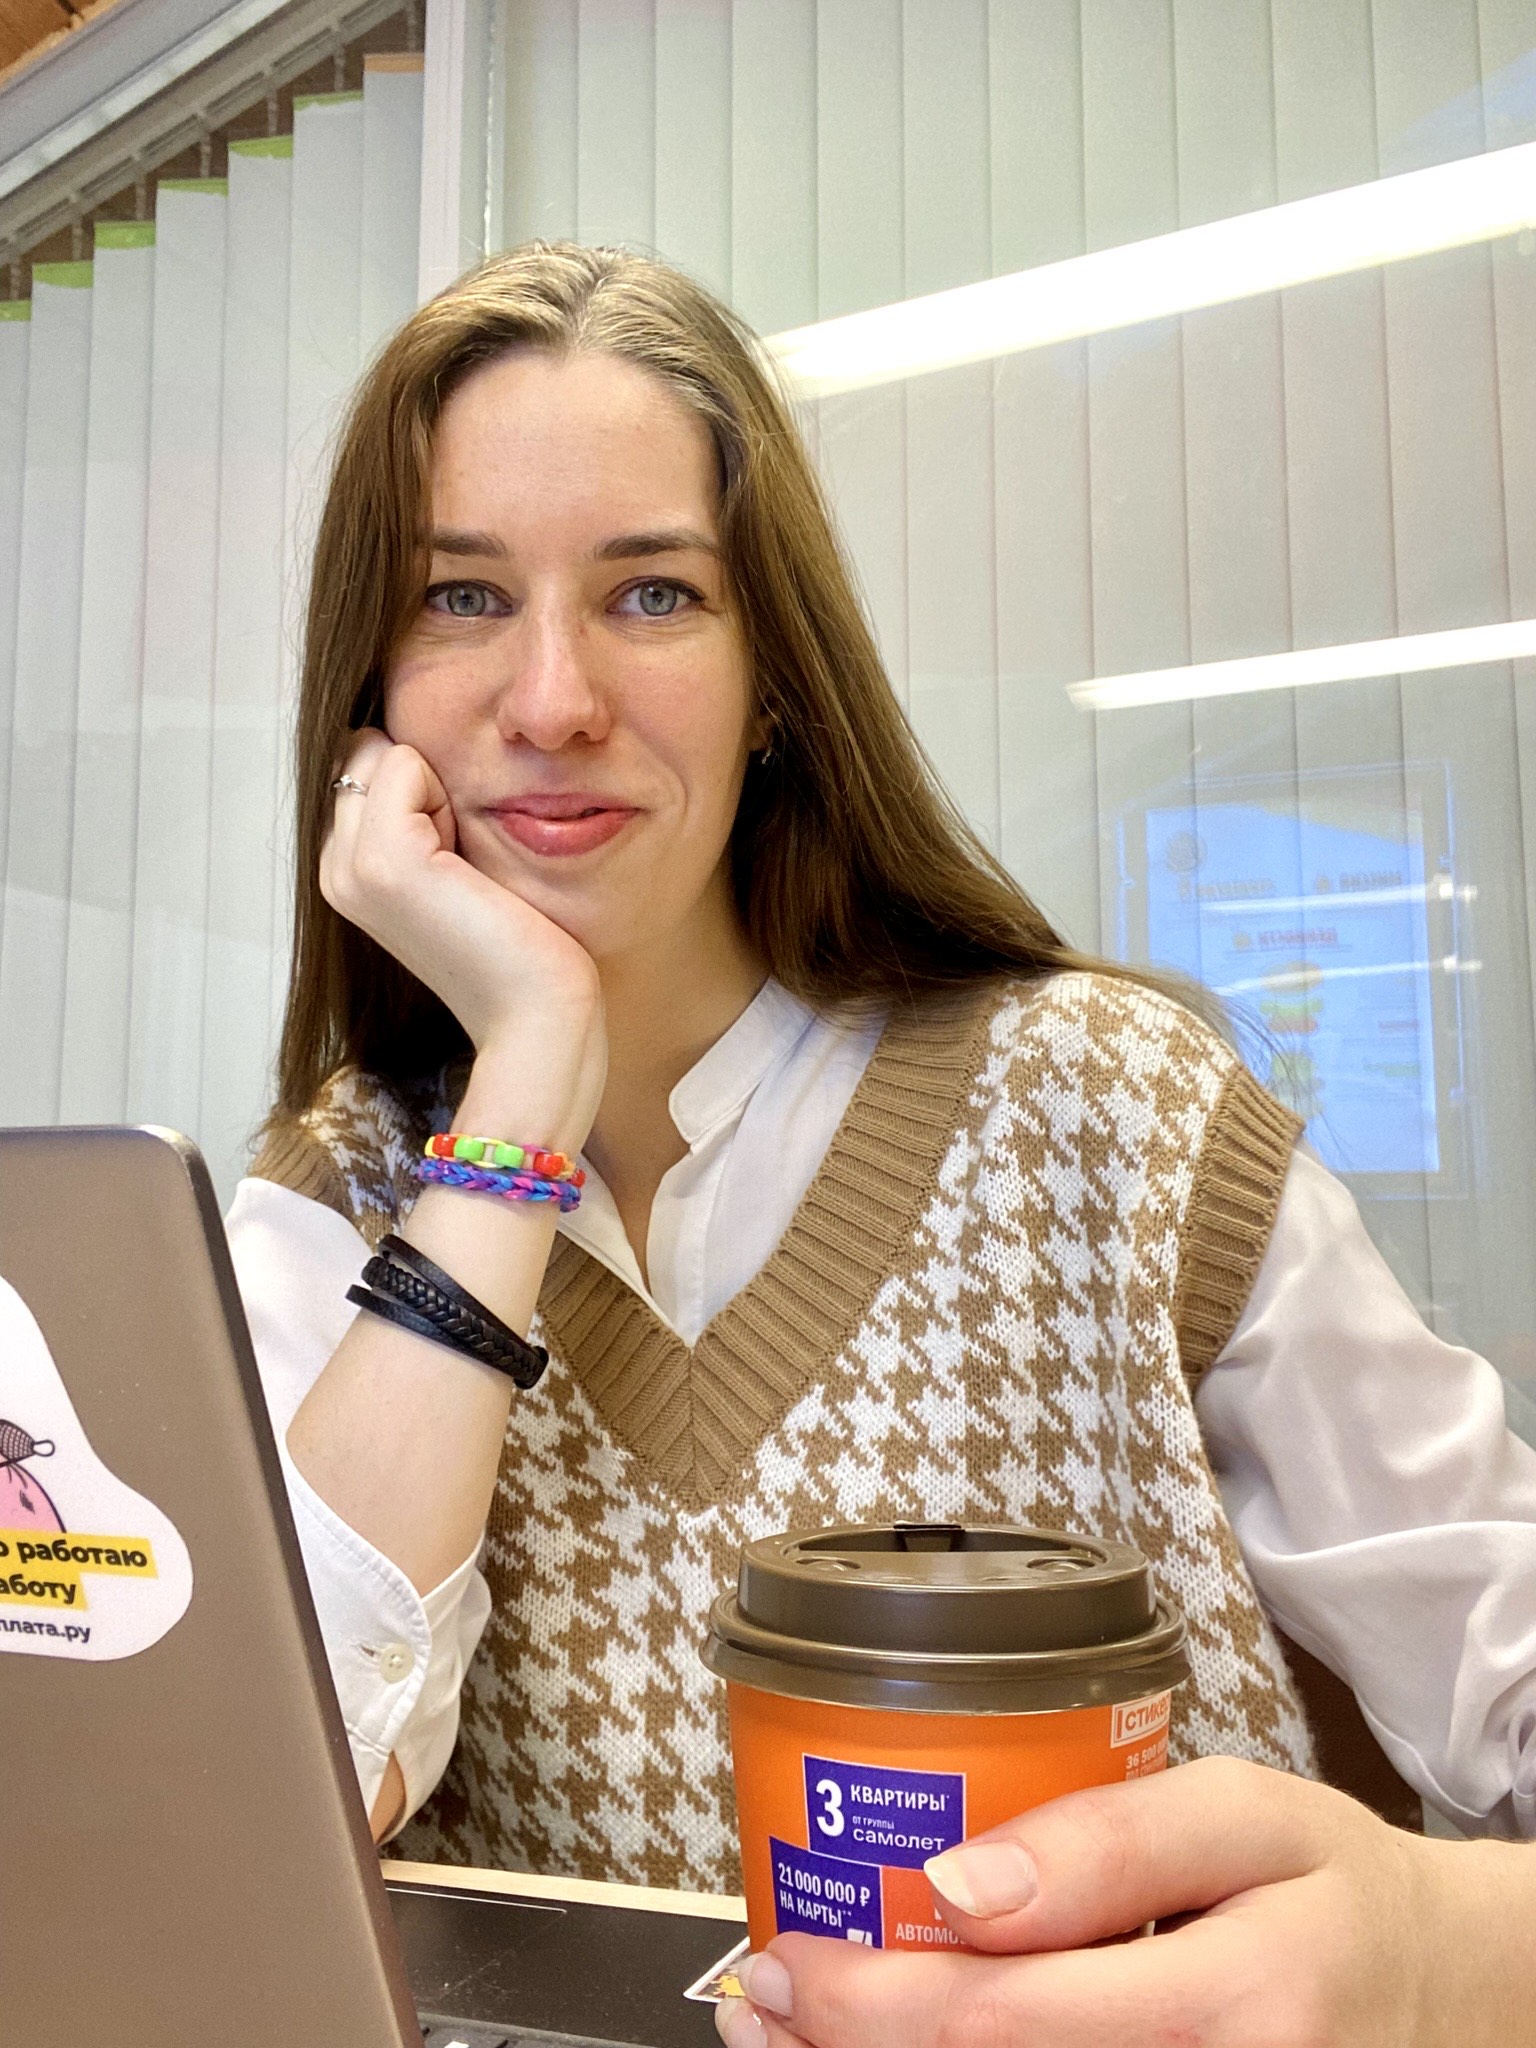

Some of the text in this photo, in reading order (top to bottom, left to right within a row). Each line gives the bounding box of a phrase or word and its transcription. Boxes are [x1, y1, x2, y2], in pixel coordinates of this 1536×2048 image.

[16, 1539, 148, 1567] работаю
[816, 1779, 845, 1837] 3
[853, 1828, 945, 1850] самолет
[779, 1889, 794, 1912] НА
[824, 1880, 855, 1905] 000
